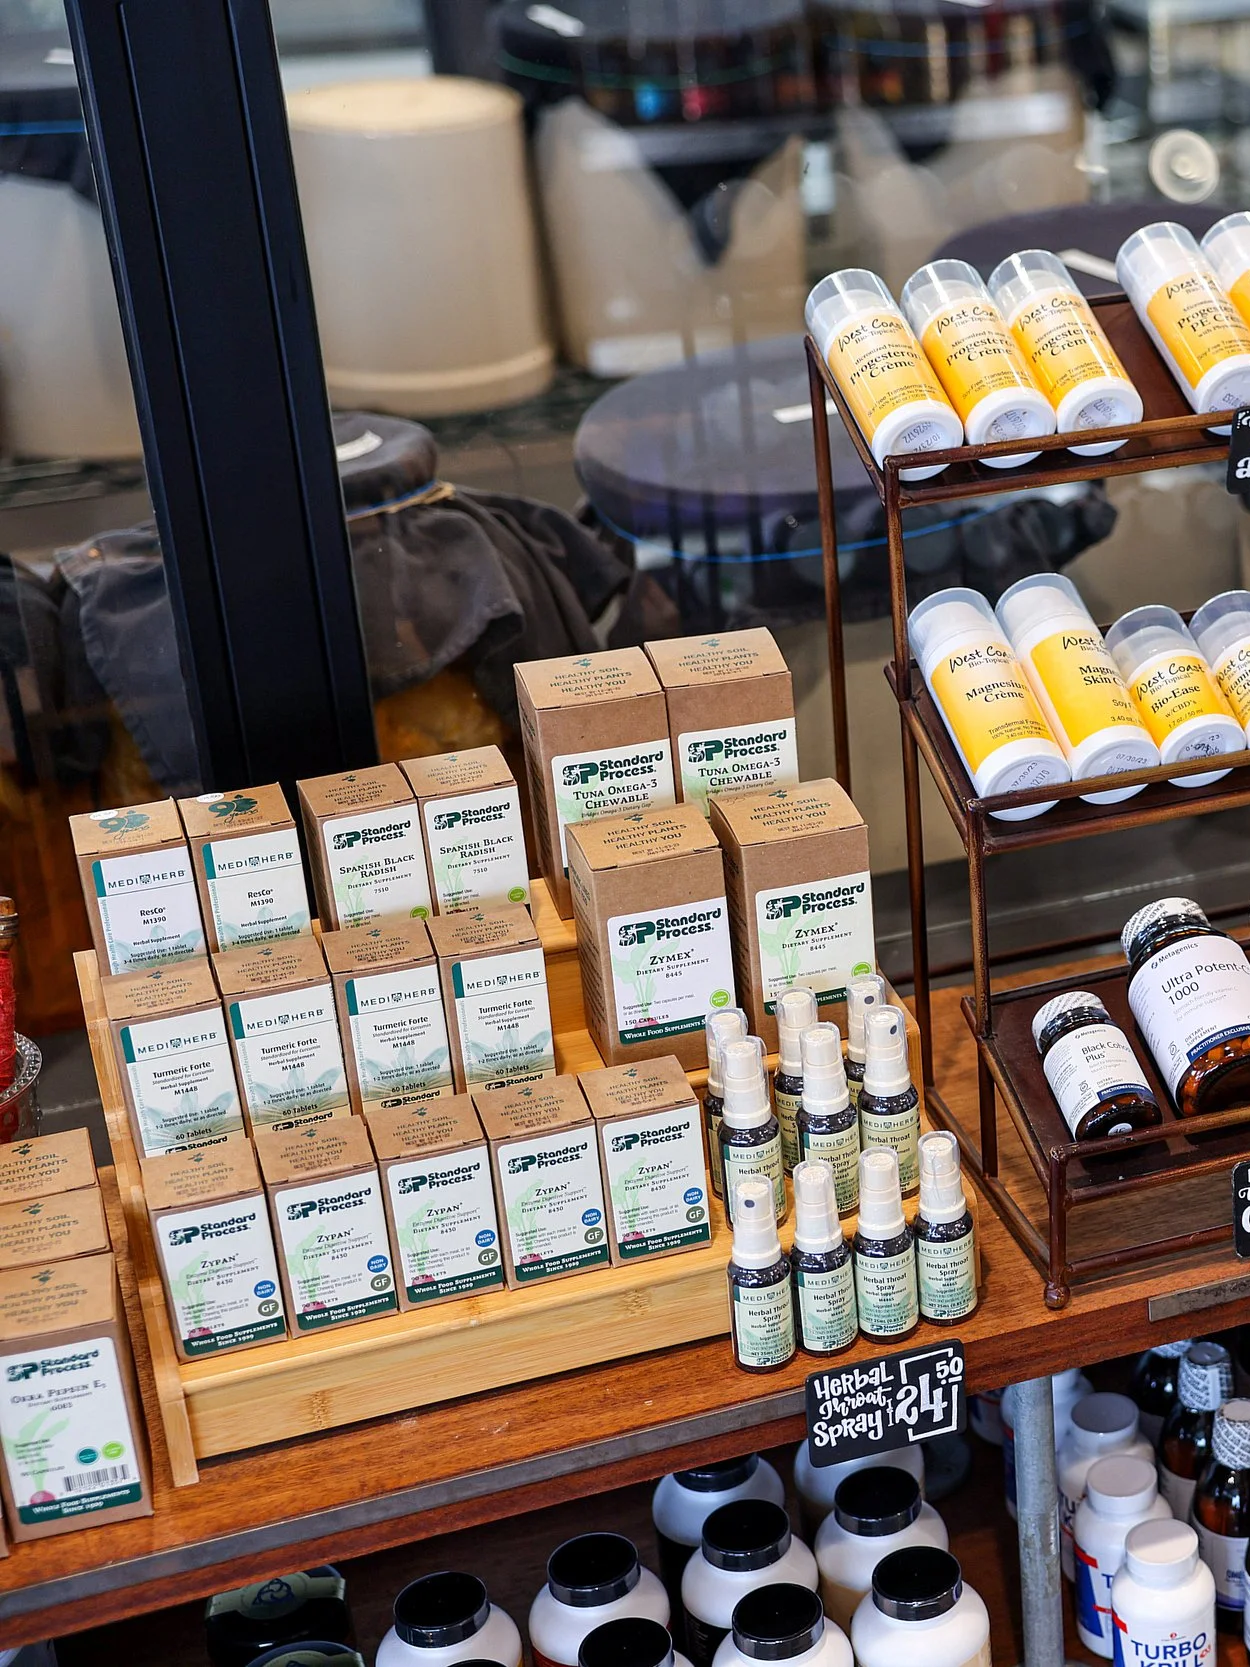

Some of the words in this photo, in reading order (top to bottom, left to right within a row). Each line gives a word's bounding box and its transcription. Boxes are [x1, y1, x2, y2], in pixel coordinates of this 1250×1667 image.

[838, 325, 867, 352] West
[870, 360, 915, 377] Crème
[1083, 676, 1110, 686] Skin
[1136, 671, 1165, 701] West
[1169, 663, 1204, 676] Coast
[1151, 685, 1200, 714] Bio-Ease
[723, 730, 787, 750] Standard
[600, 751, 664, 771] Standard
[698, 768, 728, 778] TUNA
[731, 757, 780, 774] OMEGA-3
[710, 770, 772, 786] CHEWABLE
[573, 790, 604, 800] TUNA
[608, 779, 658, 796] OMEGA-3
[585, 793, 649, 810] CHEWABLE
[602, 833, 645, 844] HEALTHY
[647, 824, 687, 836] PLANTS
[608, 825, 650, 836] HEALTHY
[652, 819, 676, 829] SOIL
[439, 842, 481, 855] SPANISH
[483, 836, 514, 846] BLACK
[616, 838, 658, 850] HEALTHY
[660, 832, 682, 841] YOU
[460, 847, 496, 859] RADISH
[339, 861, 381, 874] SPANISH
[384, 854, 415, 865] BLACK
[360, 866, 397, 879] RADISH
[801, 882, 865, 902] Standard
[251, 898, 274, 907] M1390
[140, 908, 164, 917] ResCo
[143, 917, 167, 925] M1390
[656, 908, 722, 928] Standard
[795, 925, 835, 939] ZYMEX
[650, 951, 691, 966] ZYMEX
[1158, 942, 1199, 963] Metagenics
[636, 966, 664, 976] DIETARY
[667, 958, 710, 970] SUPPLEMENT
[1161, 970, 1193, 995] Ultra
[1168, 982, 1200, 1005] 1000
[261, 1042, 295, 1055] Turmeric
[297, 1037, 318, 1046] Forte
[1081, 1043, 1106, 1055] Black
[1191, 1032, 1223, 1056] PRACTITIONER
[1086, 1052, 1103, 1063] Plus
[153, 1066, 188, 1079] Turmeric
[190, 1060, 211, 1070] Forte
[282, 1062, 305, 1072] M1448
[506, 1065, 529, 1073] Tablets
[174, 1086, 198, 1096] M1448
[176, 1132, 185, 1140] 60
[186, 1127, 212, 1138] Tablets
[317, 1230, 351, 1243] ZYPAN
[200, 1254, 236, 1269] ZYPAN
[950, 1257, 969, 1267] Throat
[864, 1275, 884, 1283] Herbal
[886, 1273, 907, 1283] Throat
[876, 1283, 896, 1291] Spray
[261, 1303, 275, 1312] GF
[305, 1312, 328, 1321] WHOLE
[330, 1308, 345, 1317] FOOD
[347, 1296, 389, 1312] SUPPLEMENTS
[331, 1312, 349, 1320] SINCE
[351, 1308, 366, 1317] 1929
[819, 1387, 892, 1420] Throat
[1131, 1633, 1206, 1659] TURBO
